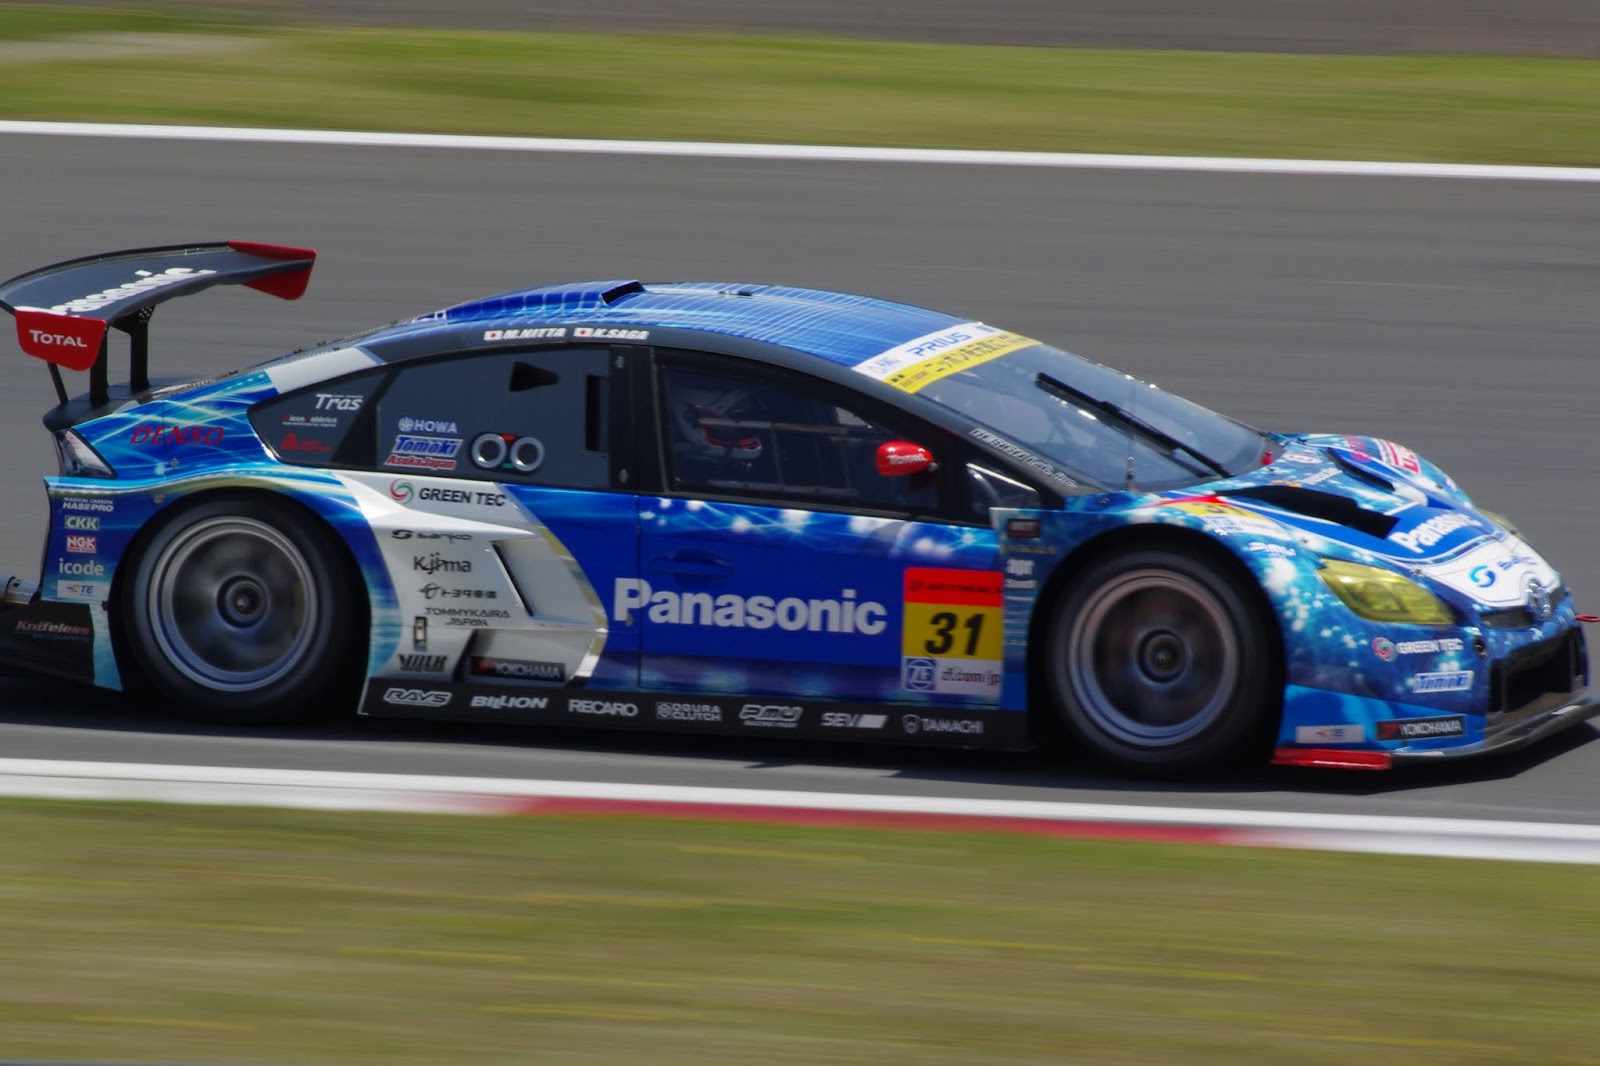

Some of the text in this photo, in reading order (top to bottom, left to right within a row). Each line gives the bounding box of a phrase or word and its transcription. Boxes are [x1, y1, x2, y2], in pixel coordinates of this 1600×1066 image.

[29, 330, 88, 348] TOTAL
[906, 332, 972, 357] PRIUS
[315, 393, 363, 410] Tras
[129, 425, 225, 446] DENSO
[414, 420, 458, 434] HOWA
[419, 487, 506, 507] GREEN TEC
[67, 516, 97, 530] CKK
[67, 537, 96, 548] NGK
[59, 557, 104, 576] icode
[613, 577, 888, 636] Panasonic
[924, 612, 985, 656] 31
[383, 688, 453, 707] RAYS
[470, 695, 548, 710] BILLION
[568, 699, 639, 717] RECARO
[922, 718, 984, 734] TAMACHI
